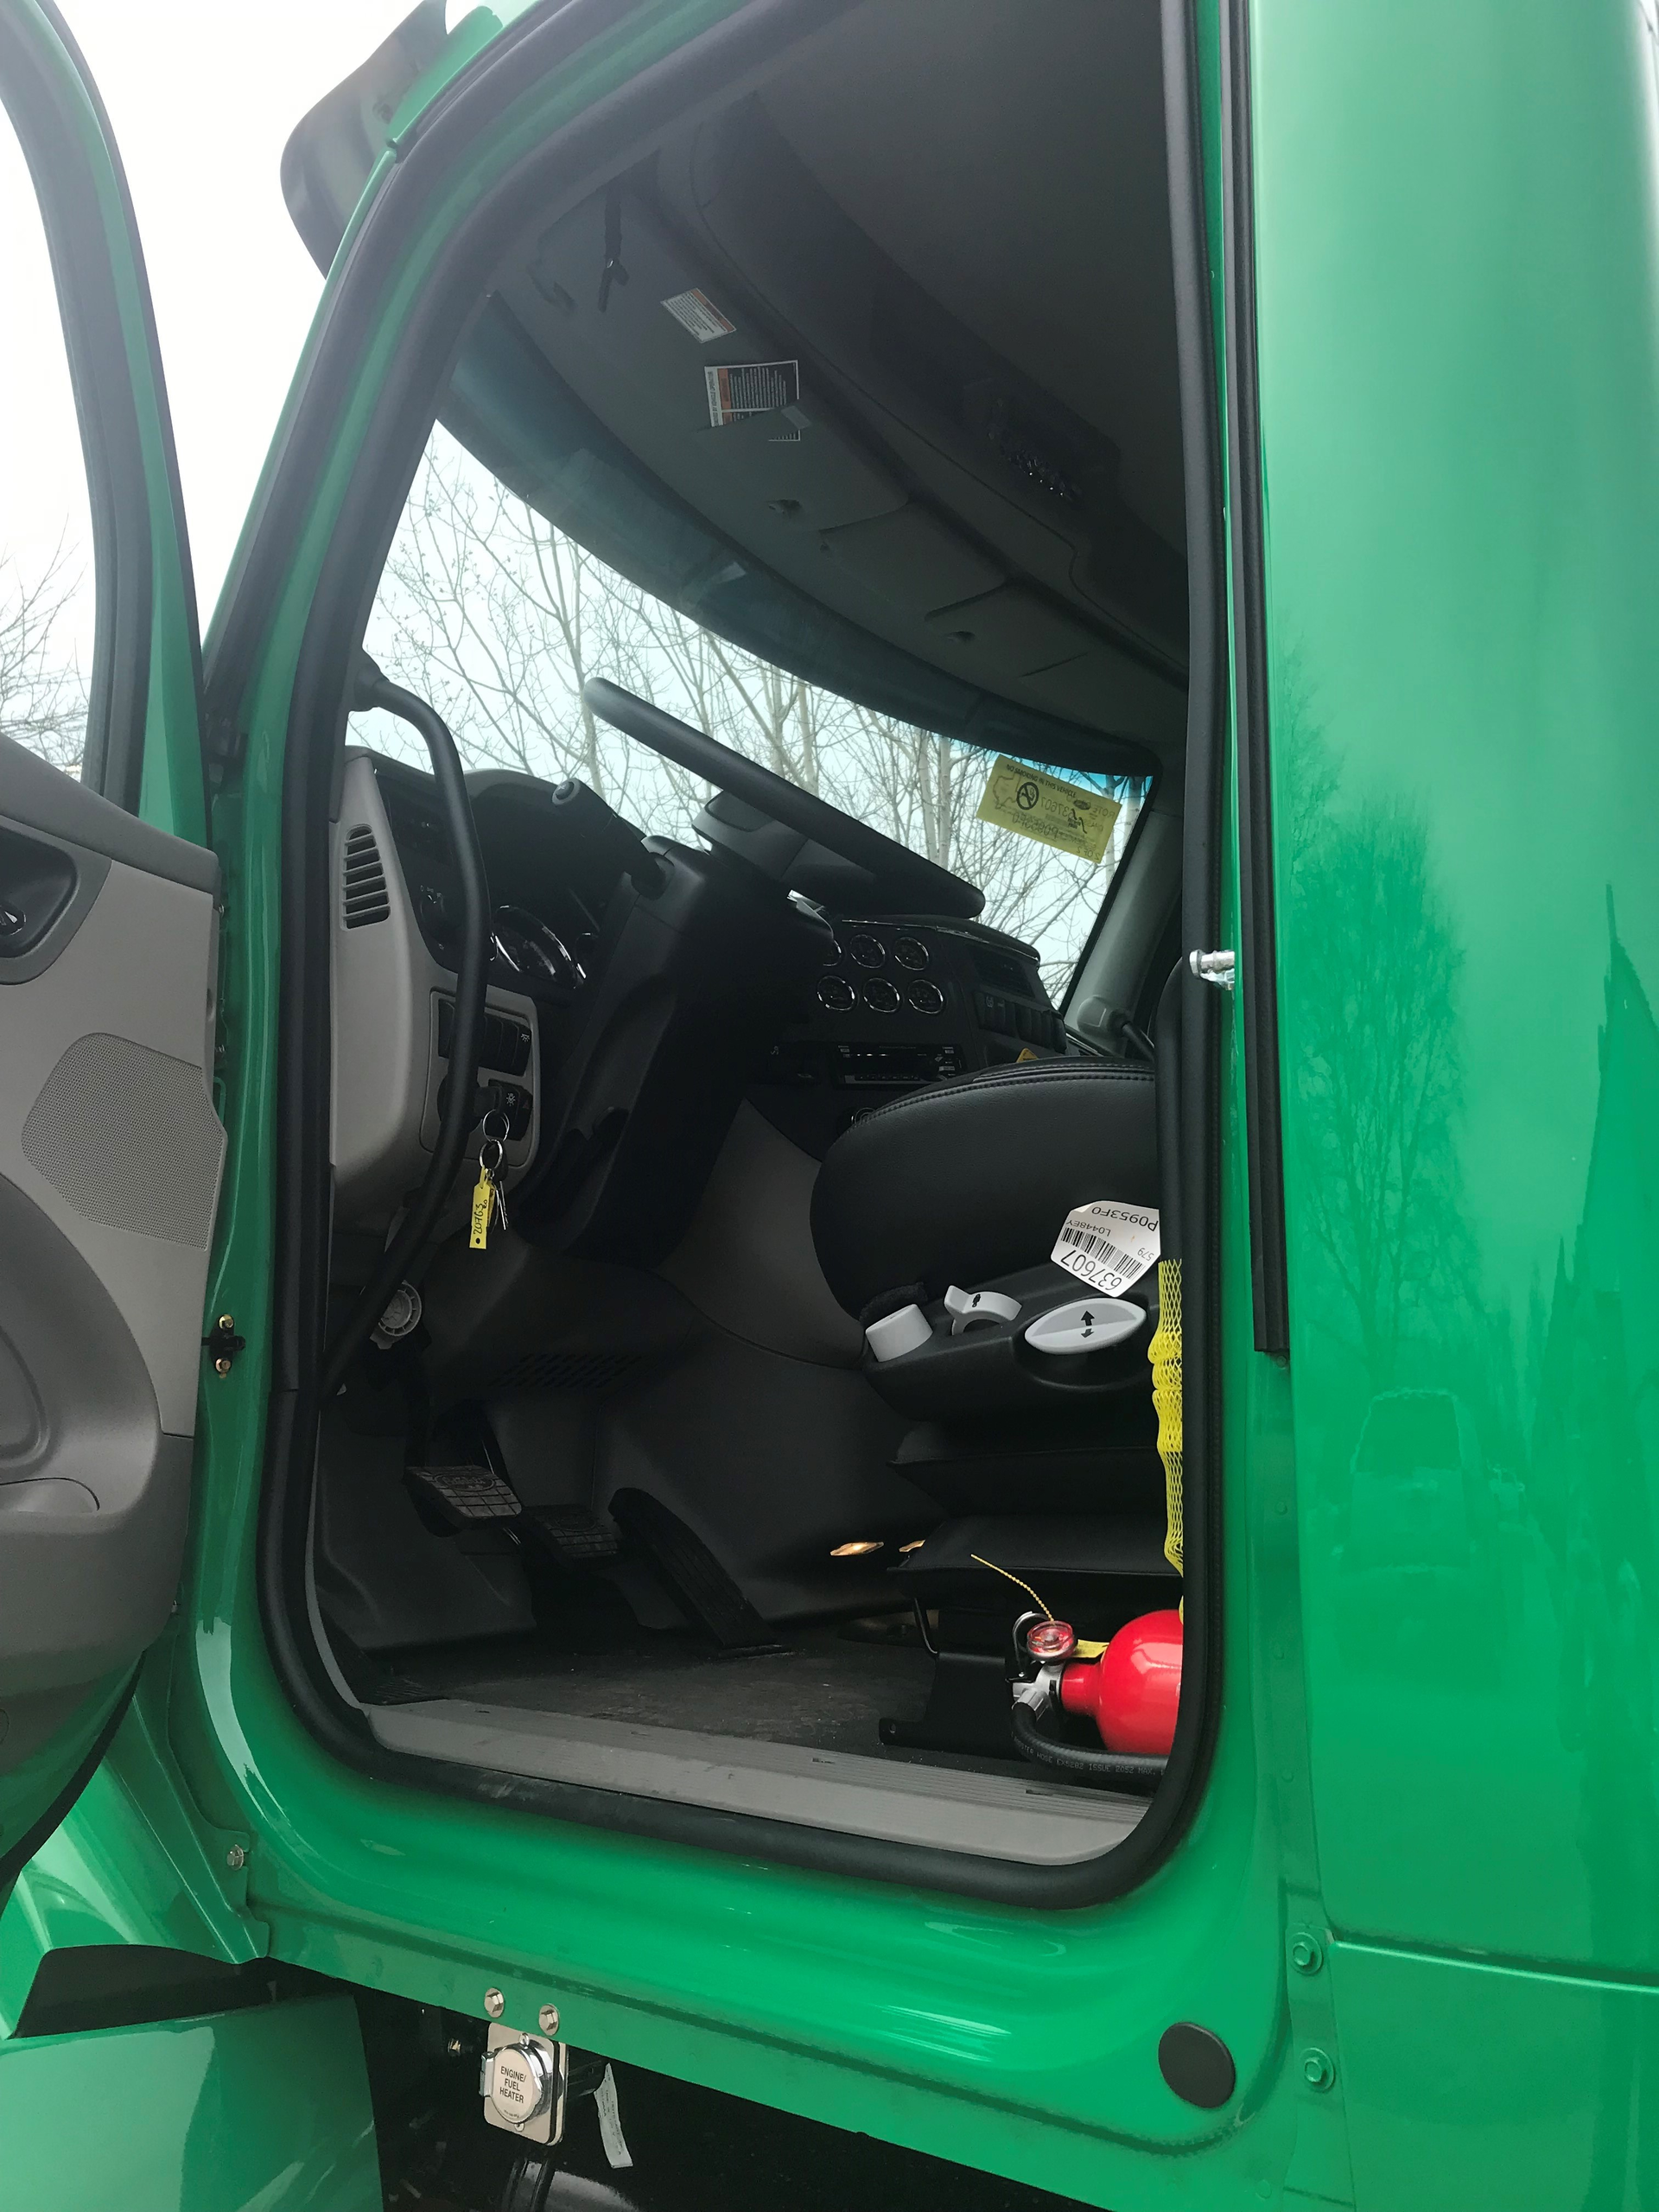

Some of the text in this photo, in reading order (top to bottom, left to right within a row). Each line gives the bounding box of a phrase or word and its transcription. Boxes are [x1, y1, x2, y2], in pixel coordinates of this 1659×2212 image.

[1014, 767, 1038, 781] SMOKING
[1045, 780, 1057, 789] THIS
[1057, 785, 1077, 798] VEHICLE
[1065, 1219, 1111, 1236] L0448EY
[1091, 1206, 1159, 1232] P0953F0
[1137, 1248, 1154, 1262] 579
[1060, 1249, 1122, 1291] 637607
[1037, 1752, 1052, 1764] HOSE
[500, 2066, 527, 2082] ENGINE/
[505, 2079, 520, 2091] FUEL
[499, 2086, 524, 2103] HEATER
